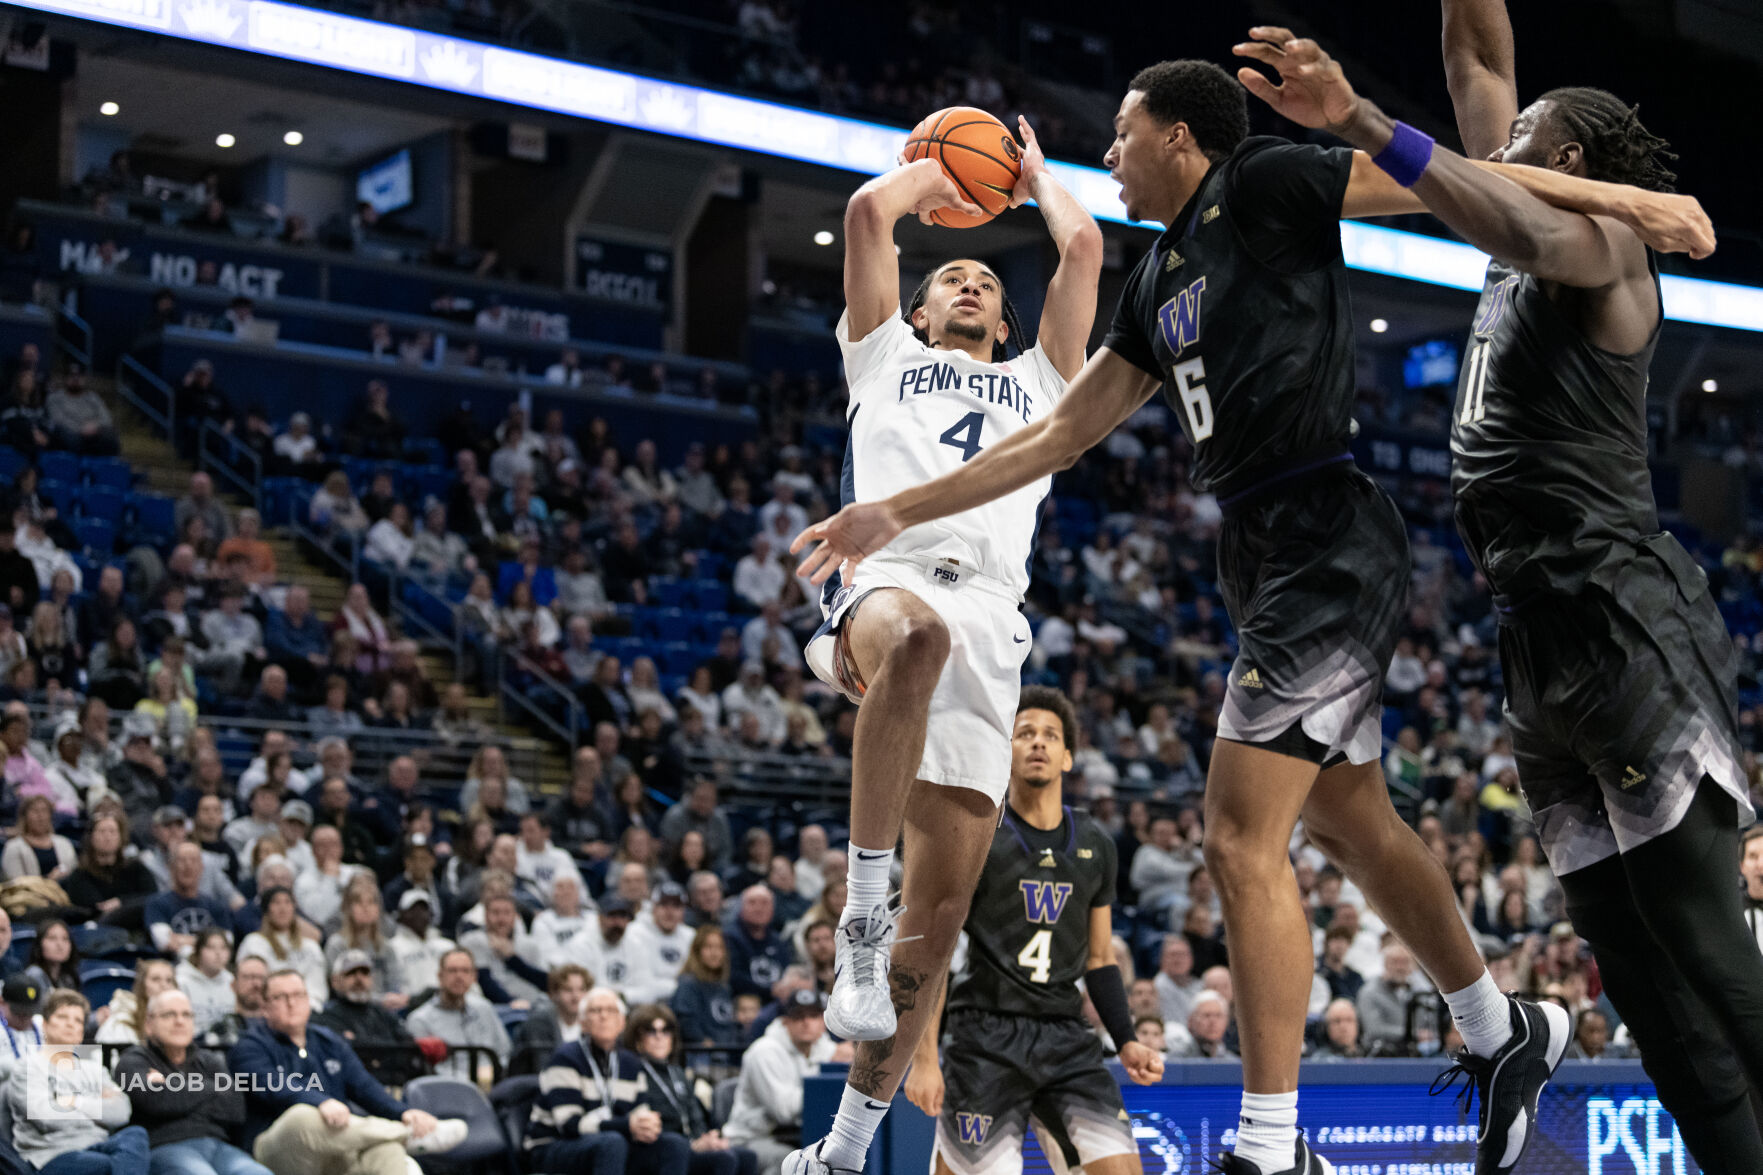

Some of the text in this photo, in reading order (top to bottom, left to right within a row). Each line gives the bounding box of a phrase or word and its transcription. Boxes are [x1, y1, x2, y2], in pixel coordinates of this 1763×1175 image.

[150, 252, 196, 287] NO
[218, 262, 285, 299] ACT
[1158, 275, 1206, 358] W
[898, 362, 1033, 424] PENN STATE
[1172, 355, 1215, 443] 6
[1459, 341, 1490, 425] 11
[939, 411, 985, 462] 4
[933, 567, 959, 583] PSU
[1019, 879, 1073, 924] W
[1018, 929, 1052, 984] 4
[956, 1111, 993, 1145] W
